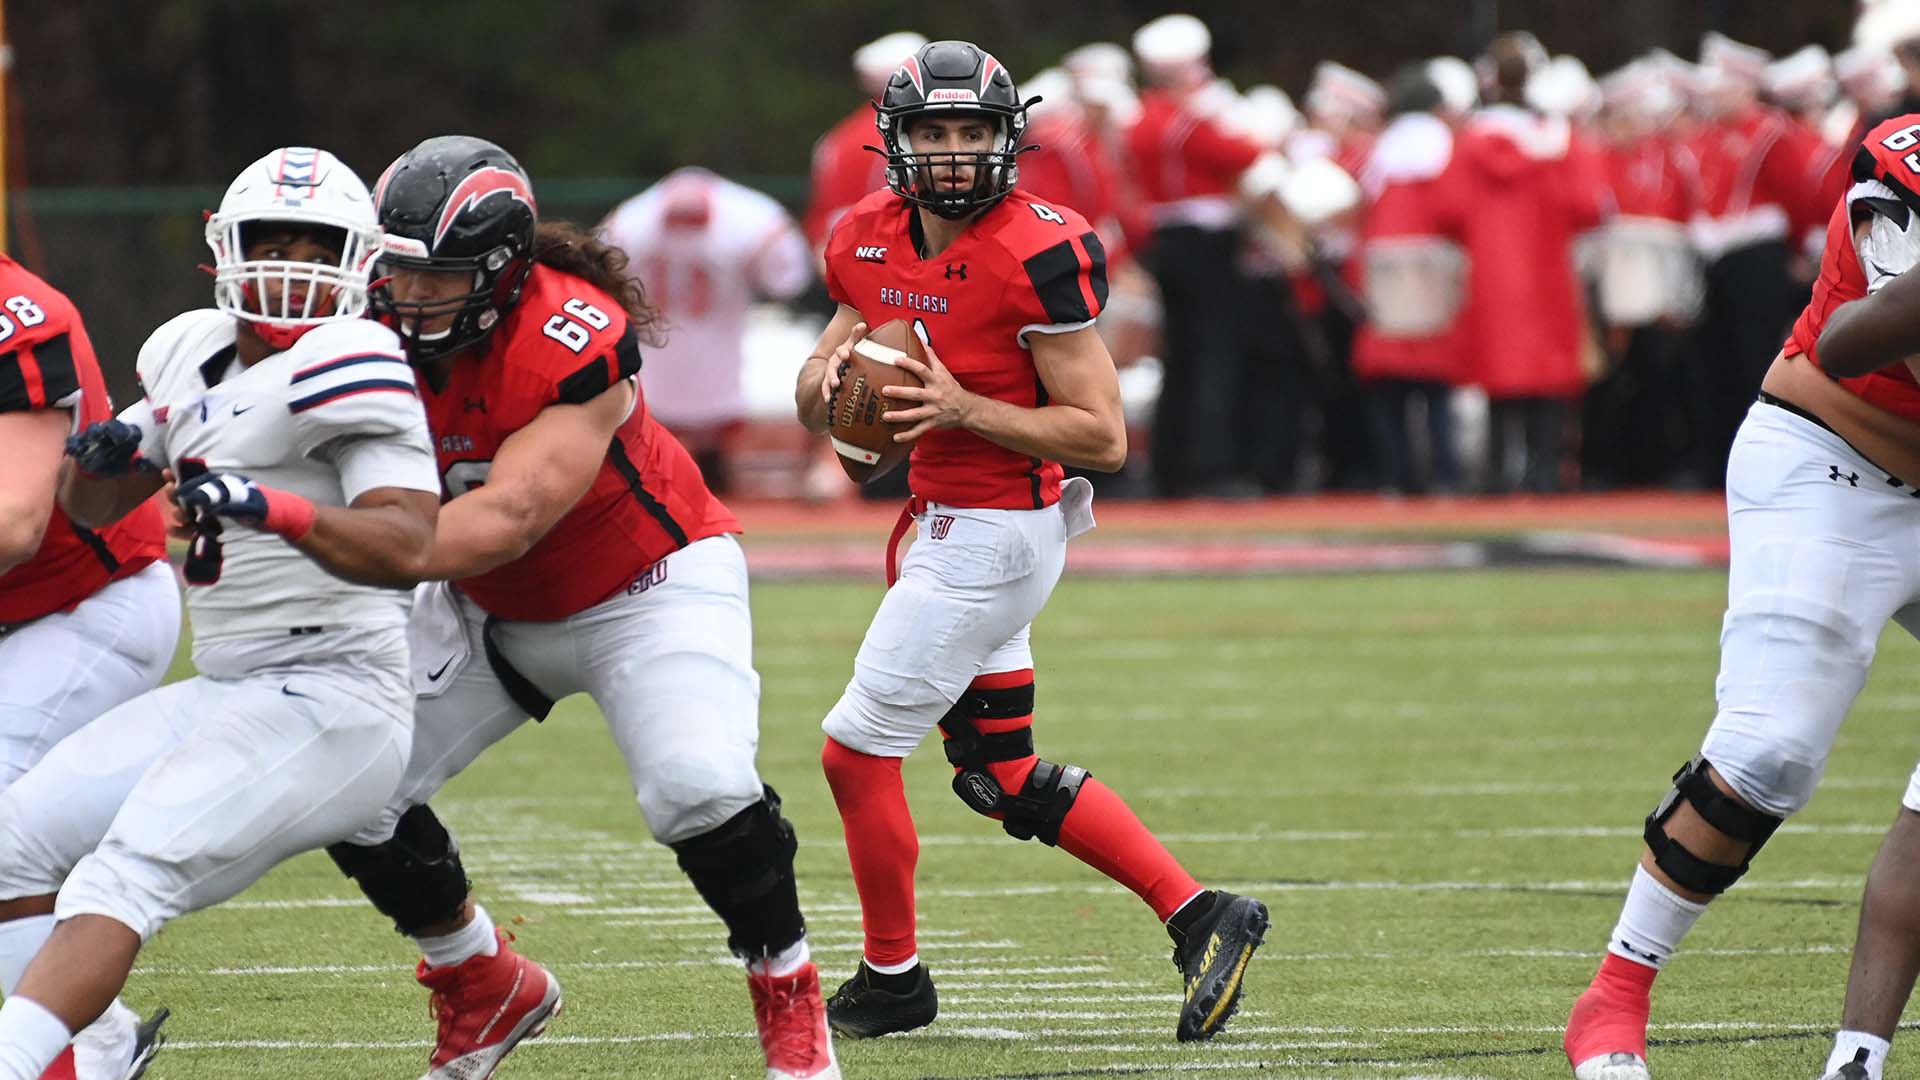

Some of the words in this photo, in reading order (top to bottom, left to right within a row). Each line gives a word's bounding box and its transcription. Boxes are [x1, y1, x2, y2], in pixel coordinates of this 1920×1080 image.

[933, 91, 973, 100] Riddell
[1027, 202, 1067, 226] 4
[855, 246, 888, 259] NEC
[880, 286, 902, 307] RED
[907, 292, 949, 315] FLASH
[541, 296, 611, 355] 66
[841, 376, 866, 428] Wilson
